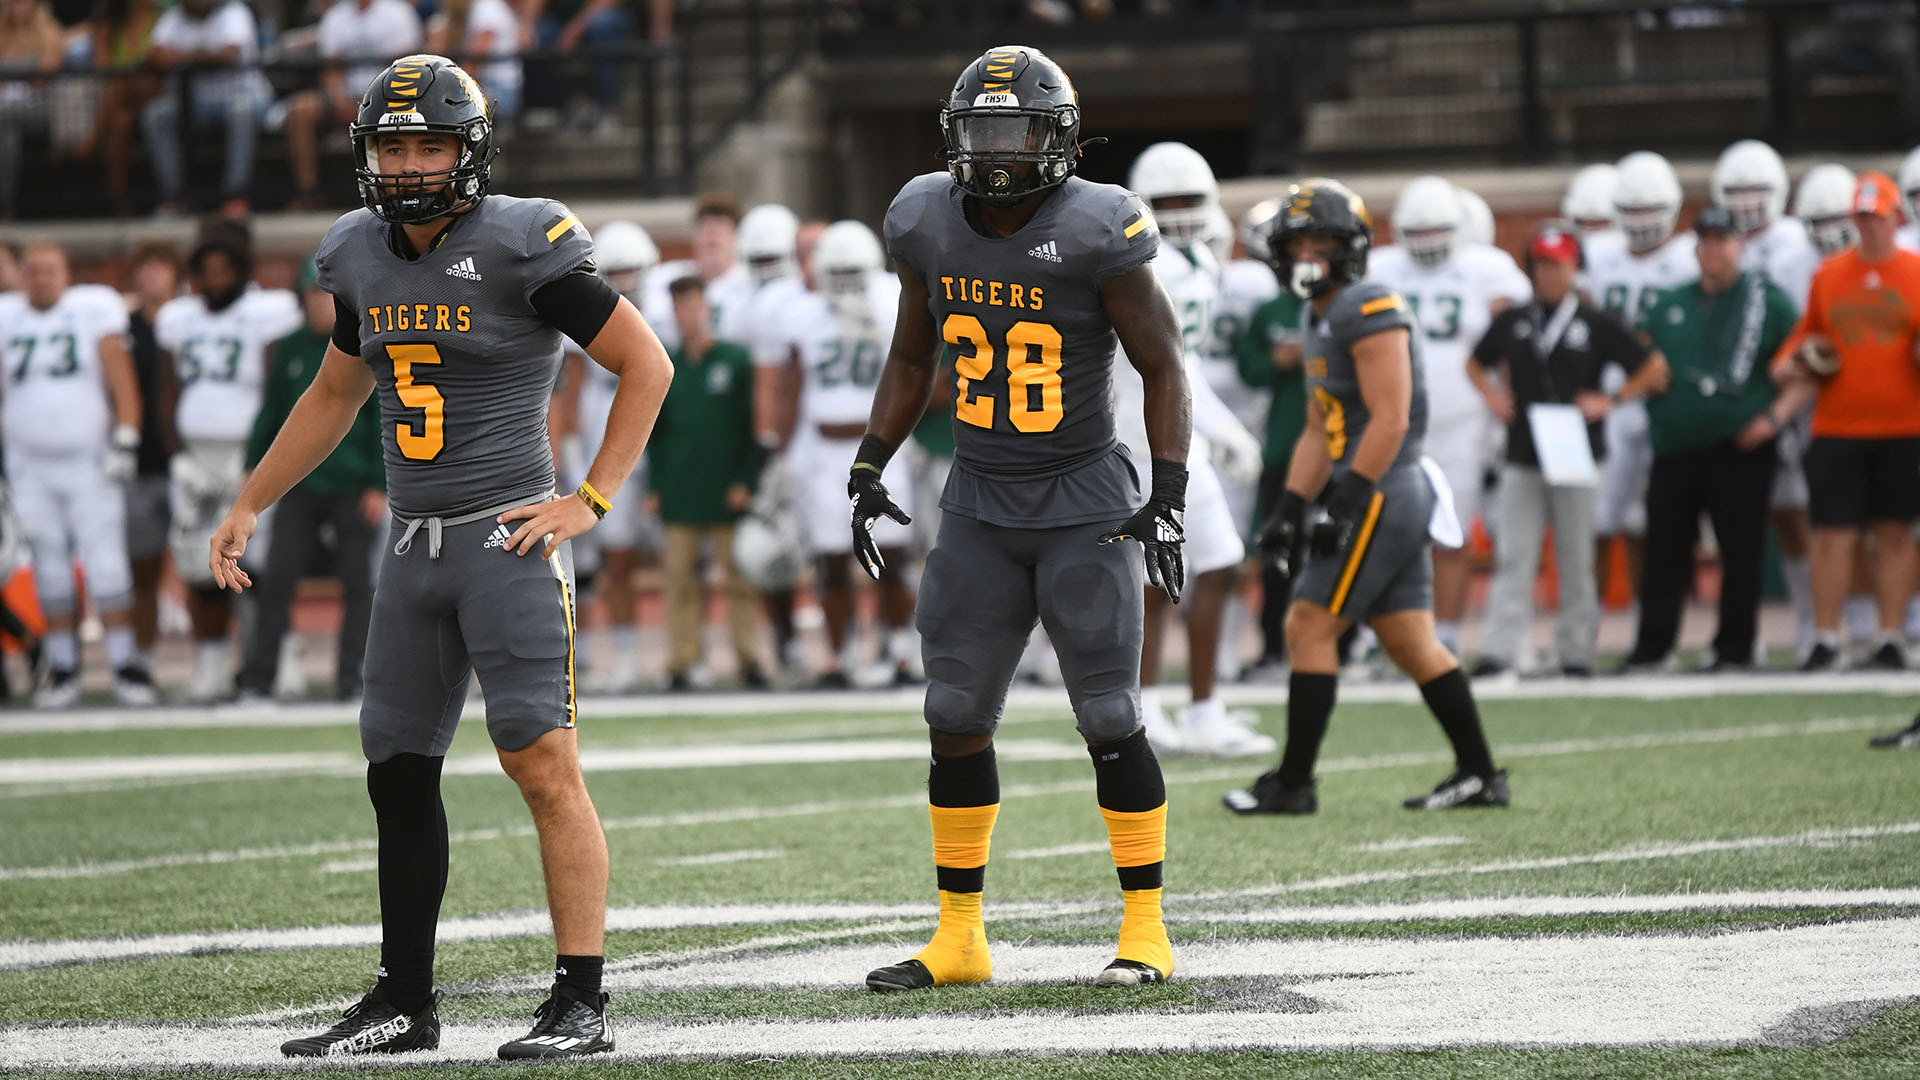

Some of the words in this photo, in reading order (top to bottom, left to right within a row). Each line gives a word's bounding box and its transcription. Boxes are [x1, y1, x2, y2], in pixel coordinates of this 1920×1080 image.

[984, 94, 1008, 104] FHSU
[388, 114, 412, 124] FHSU
[1028, 248, 1063, 263] adidas
[445, 267, 482, 281] adidas
[940, 276, 1045, 311] TIGERS
[368, 304, 472, 333] TIGERS
[942, 313, 1065, 433] 28
[383, 341, 447, 463] 5
[483, 537, 507, 549] adid
